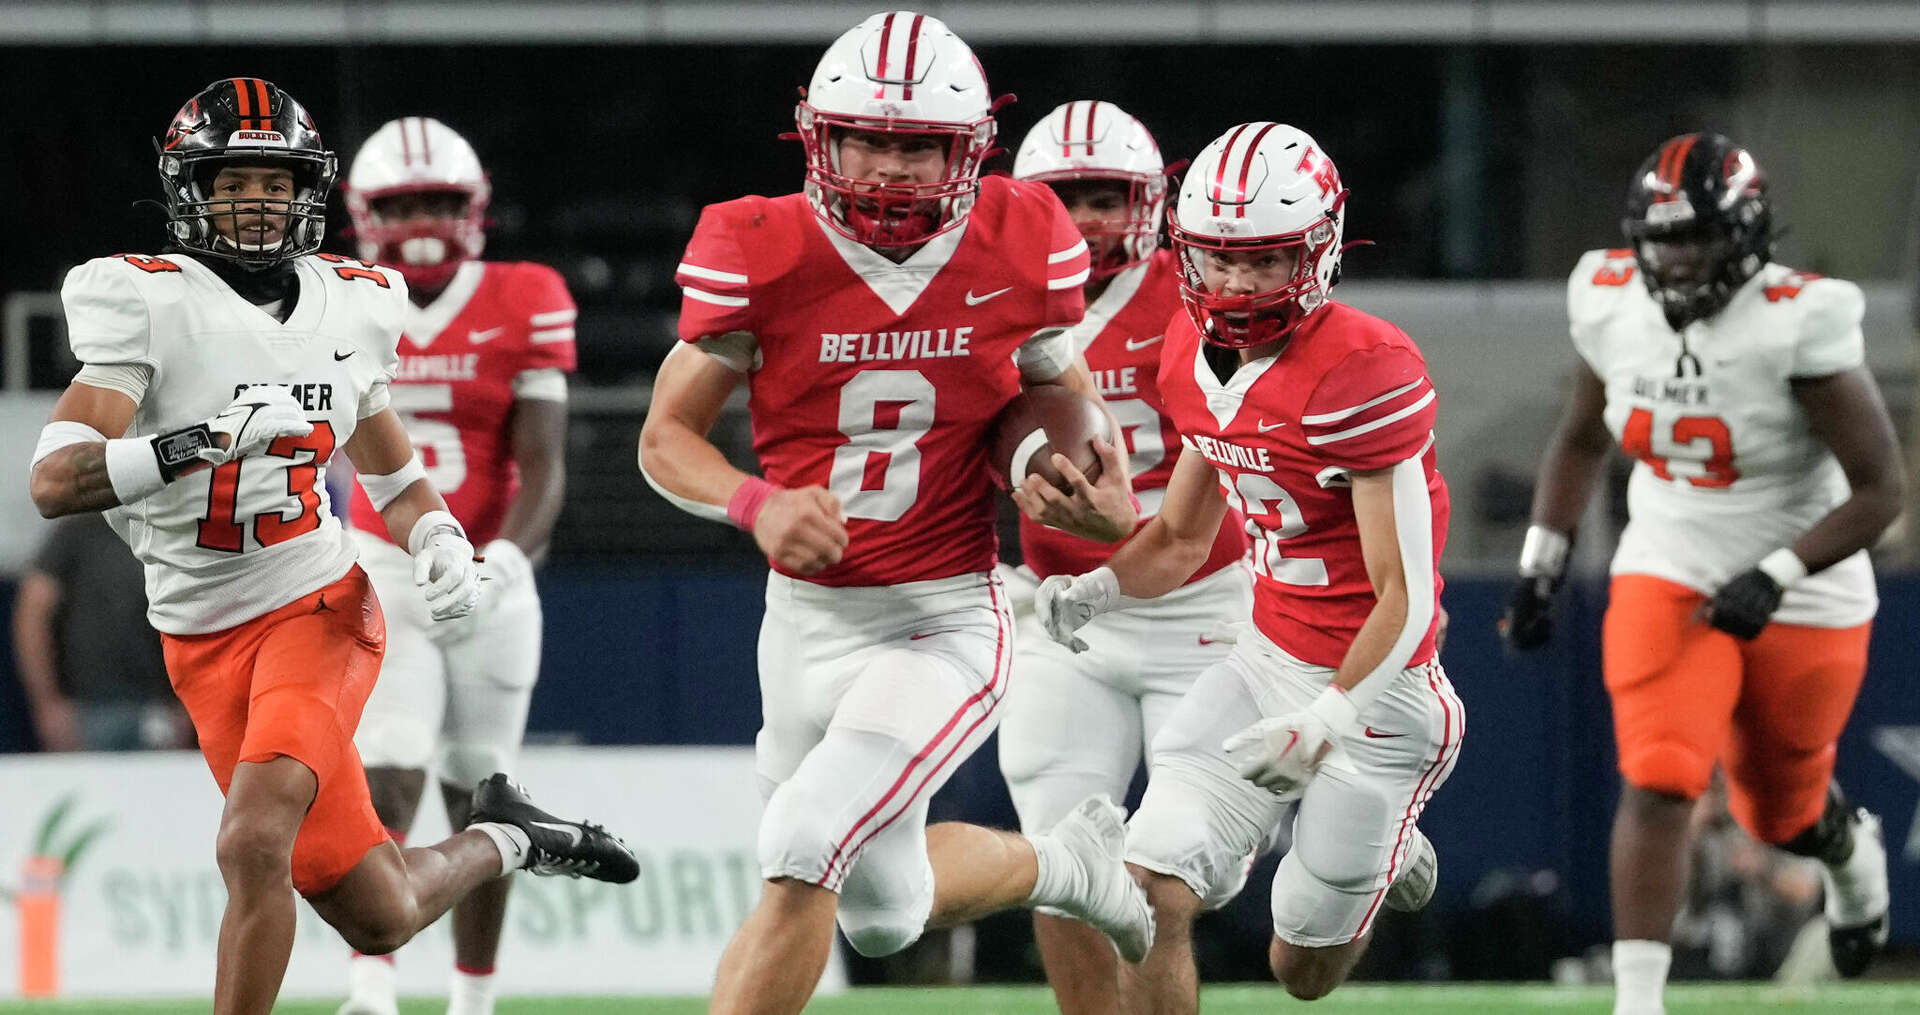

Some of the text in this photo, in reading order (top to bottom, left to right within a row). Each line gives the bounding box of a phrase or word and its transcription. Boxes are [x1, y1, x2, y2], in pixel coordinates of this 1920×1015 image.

[239, 132, 281, 141] BUCKEYES
[819, 326, 974, 363] BELLVILLE
[828, 369, 937, 522] 8
[1193, 434, 1276, 473] BELLVILLE
[1621, 407, 1740, 490] 43
[195, 419, 336, 554] 13
